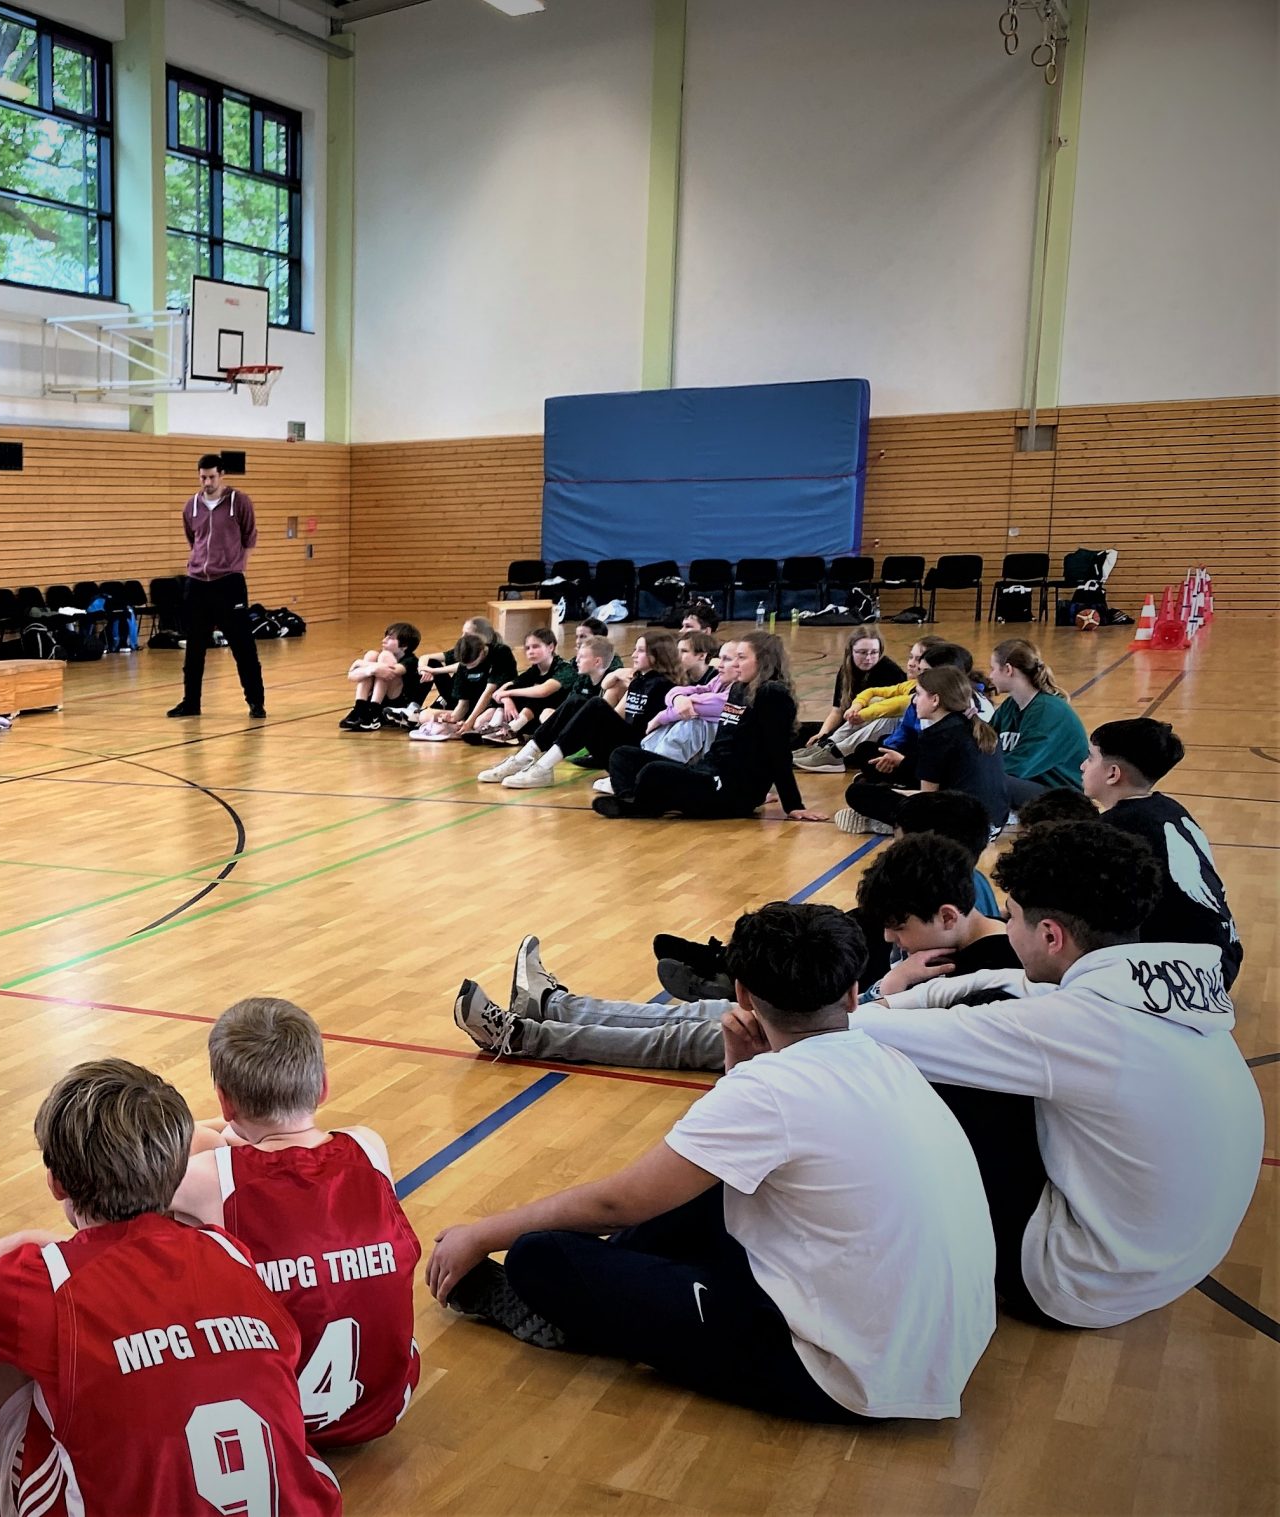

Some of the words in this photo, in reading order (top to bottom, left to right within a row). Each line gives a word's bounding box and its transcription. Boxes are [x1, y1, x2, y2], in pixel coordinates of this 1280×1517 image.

[256, 1256, 318, 1292] MPG
[322, 1241, 397, 1284] TRIER
[113, 1325, 195, 1374] MPG
[195, 1316, 280, 1354] TRIER
[297, 1317, 364, 1430] 4
[184, 1398, 280, 1517] 9
